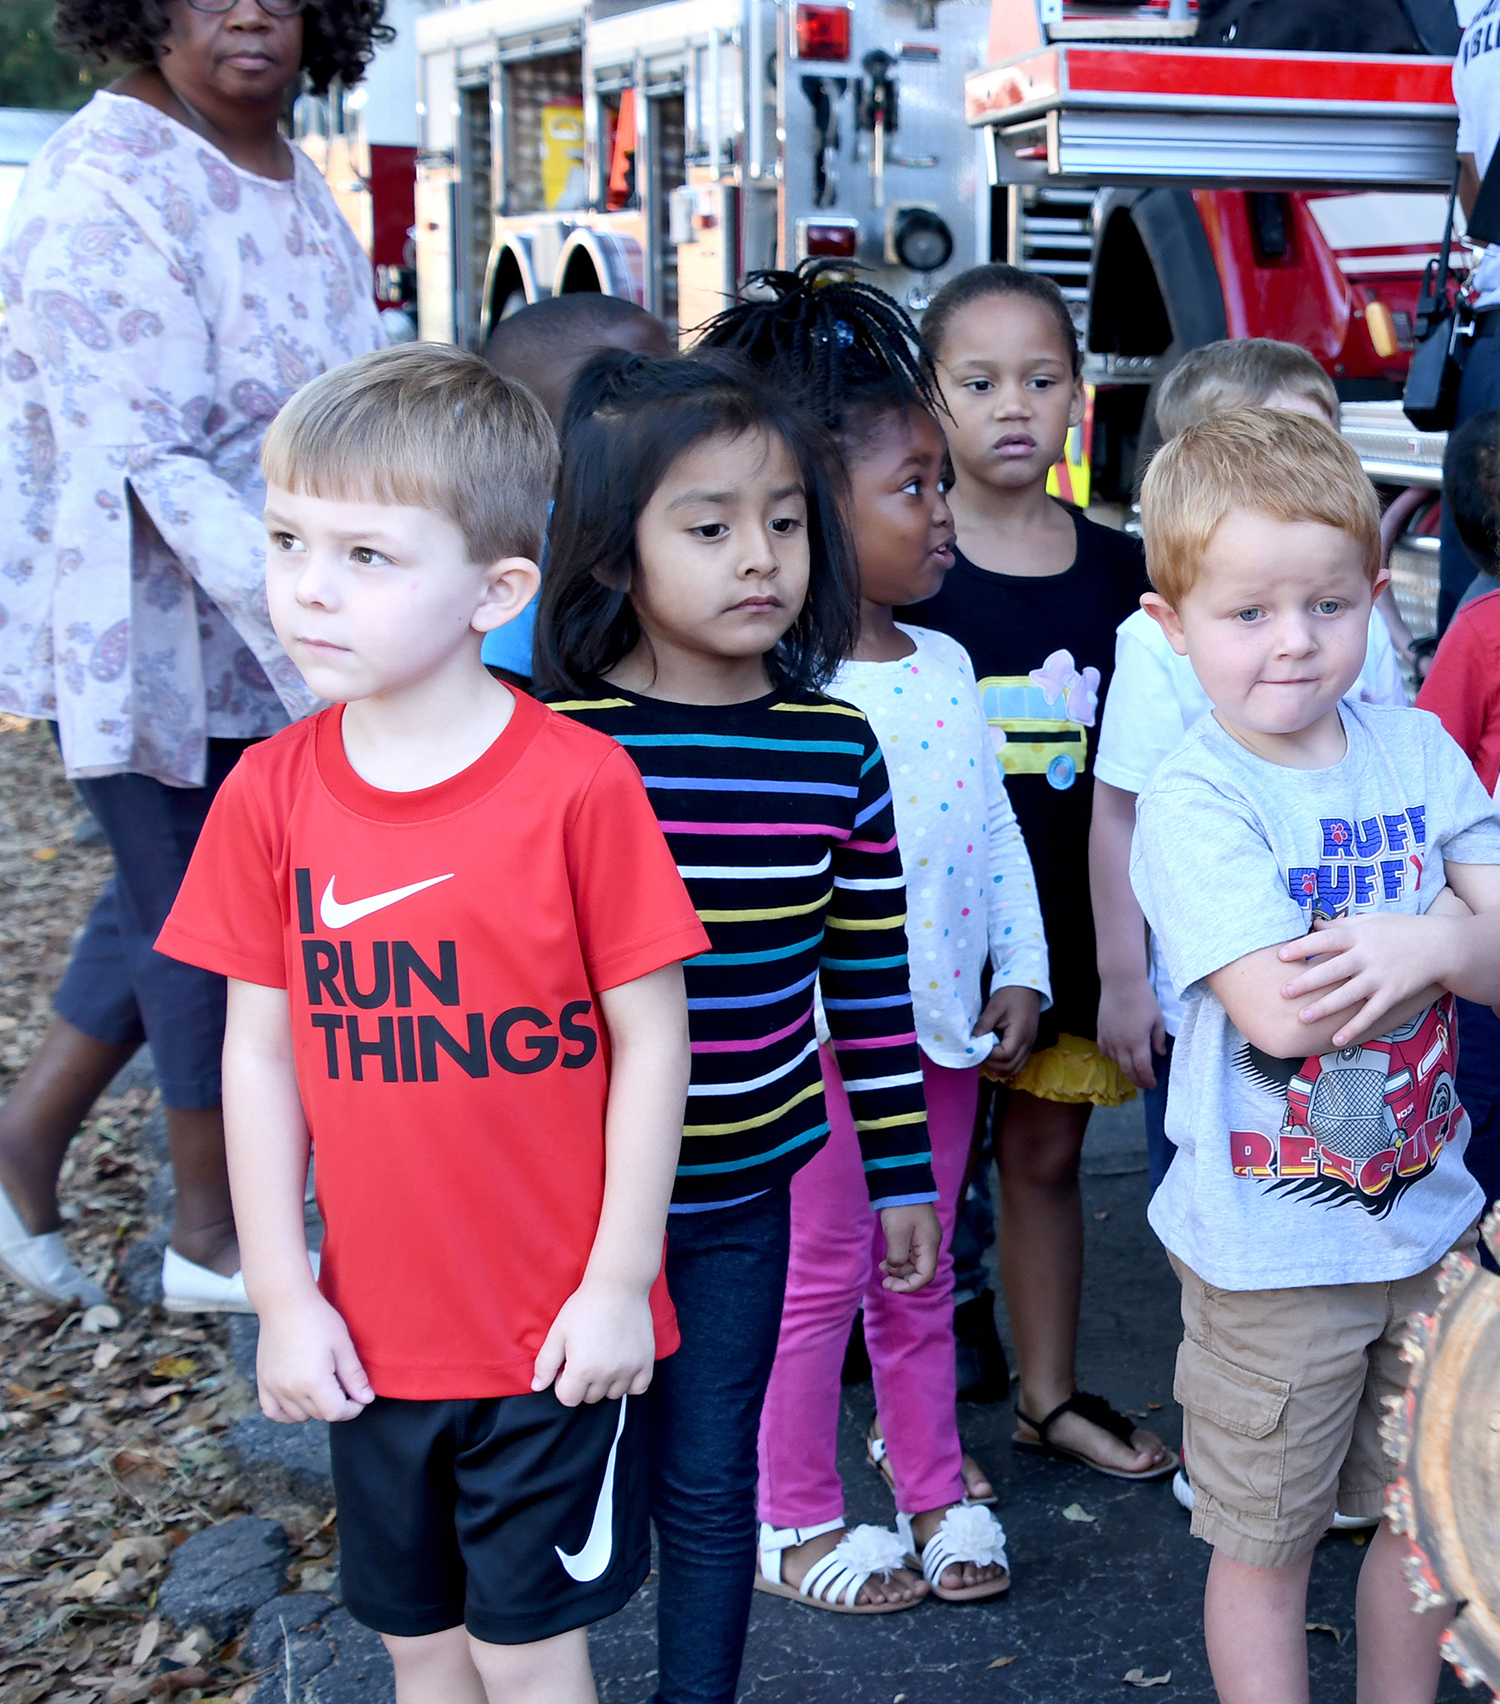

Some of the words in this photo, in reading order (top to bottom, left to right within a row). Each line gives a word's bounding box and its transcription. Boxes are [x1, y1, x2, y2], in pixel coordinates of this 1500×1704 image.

[294, 868, 315, 934] I
[300, 940, 461, 1009] RUN
[311, 1000, 598, 1083] THINGS
